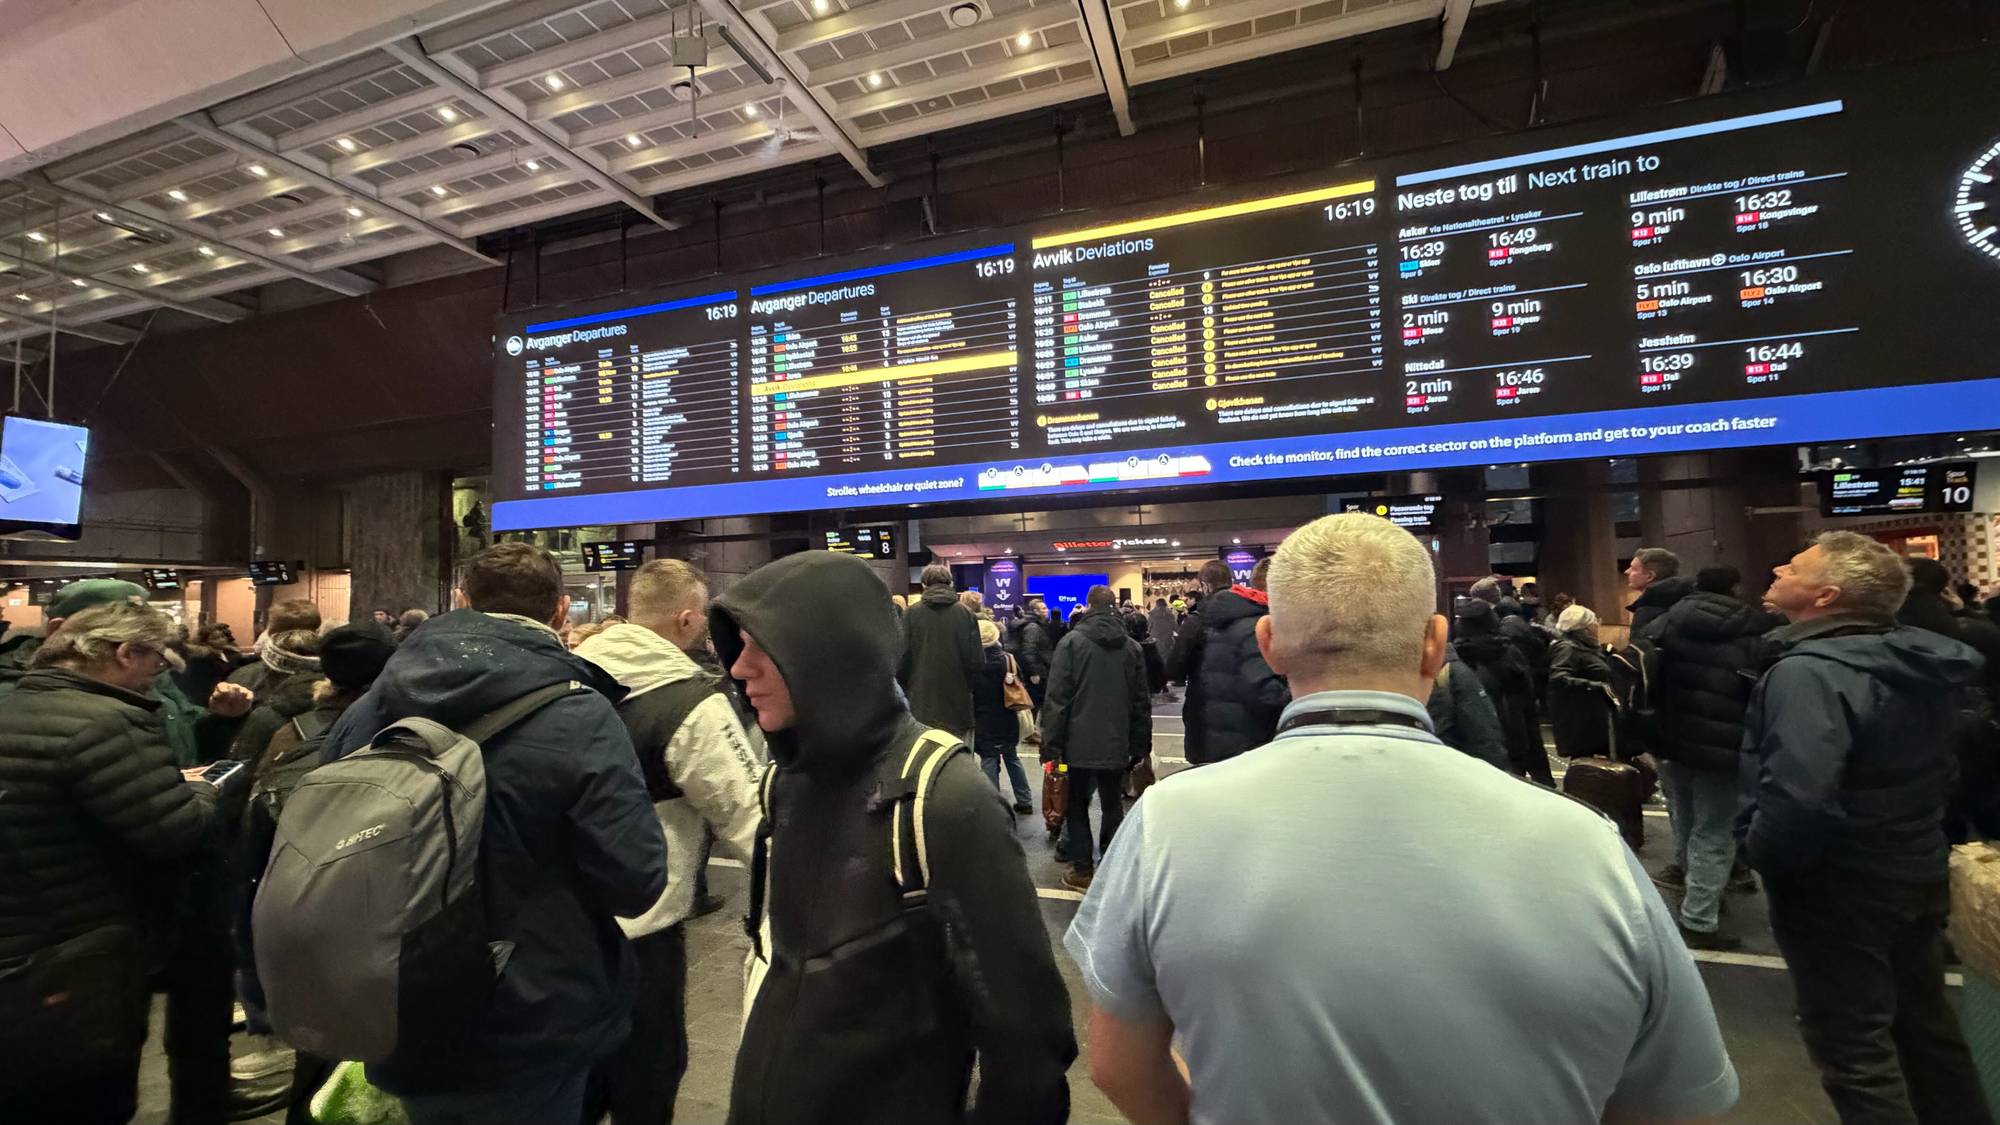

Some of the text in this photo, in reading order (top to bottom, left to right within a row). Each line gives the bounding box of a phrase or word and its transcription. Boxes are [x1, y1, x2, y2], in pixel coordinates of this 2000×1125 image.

[1398, 155, 1659, 210] Neste tog til Next train to
[1747, 175, 1776, 186] Direct
[1777, 170, 1805, 182] trains
[1324, 198, 1374, 222] 16:19
[1736, 190, 1792, 212] 16:32
[1631, 207, 1685, 227] 9 min
[1489, 227, 1536, 247] 16:49
[1033, 237, 1153, 269] Avvik Deviations
[1400, 241, 1444, 260] 16:39
[975, 259, 1014, 278] 16:19
[1635, 249, 1784, 276] Oslo lufthavn Oslo Airport
[1741, 266, 1797, 286] 16:30
[1637, 281, 1689, 299] 5 min
[1789, 281, 1822, 294] Airport
[750, 283, 874, 315] Avganger Departures
[1492, 299, 1541, 316] 9 min
[1682, 295, 1712, 307] Airport
[705, 304, 737, 320] 16:19
[1403, 311, 1448, 327] 2 min
[526, 324, 627, 350] Avganger Departures
[1746, 343, 1803, 363] 16:44
[1641, 354, 1694, 373] 16:39
[1406, 379, 1452, 395] 2 min
[1496, 369, 1544, 386] 16:46
[1230, 416, 1776, 467] Check the monitor, find the correct sector on the platform and get to your coach faster
[827, 478, 964, 497] Stroller, wheelchair or quiet zone?
[1942, 487, 1970, 504] 10
[882, 542, 889, 553] 8
[587, 557, 593, 567] 7
